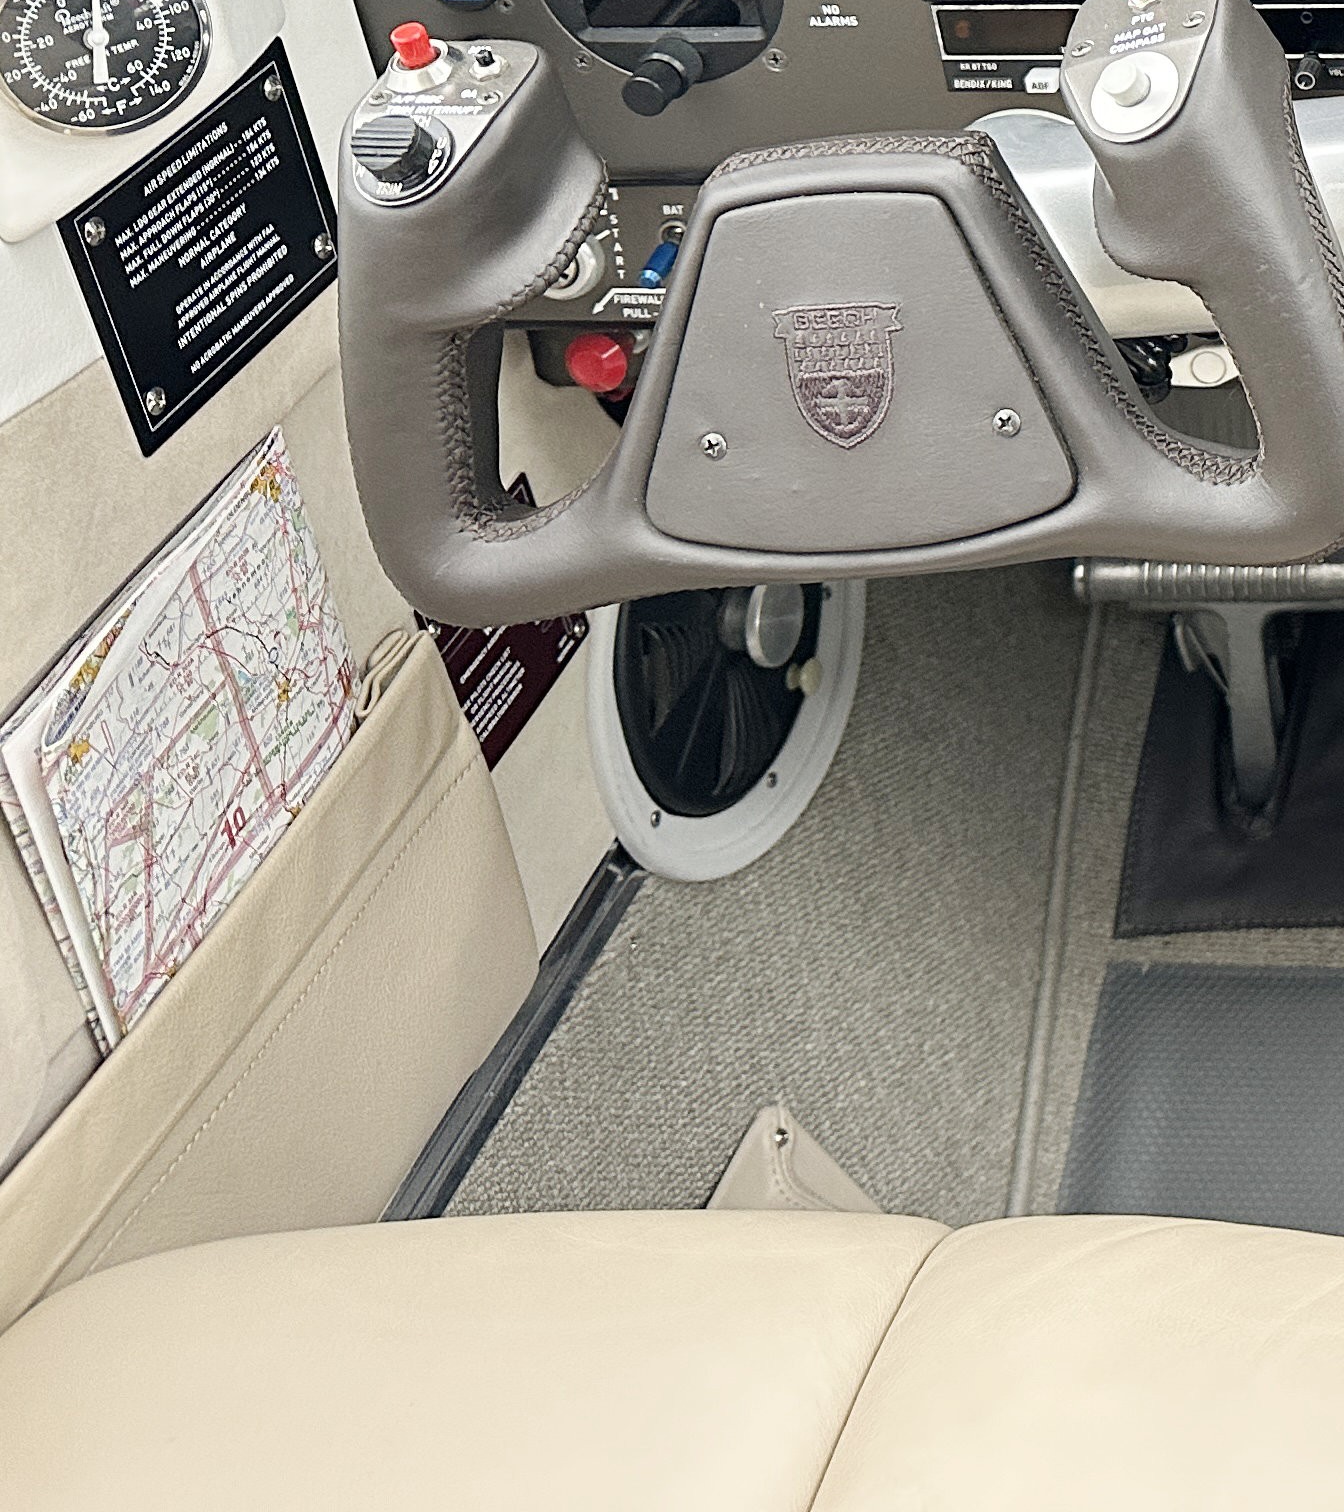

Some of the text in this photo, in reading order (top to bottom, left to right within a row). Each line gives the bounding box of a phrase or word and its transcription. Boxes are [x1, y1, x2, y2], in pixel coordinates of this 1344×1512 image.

[821, 5, 840, 16] NO
[809, 16, 858, 27] ALARMS
[171, 47, 190, 61] 120
[150, 80, 171, 95] 140
[954, 80, 1013, 88] BENDIX/KING
[144, 122, 228, 196] AIR SPEED LIMITATIONS
[662, 205, 684, 215] BAT
[610, 215, 626, 279] START
[220, 806, 248, 849] 10
